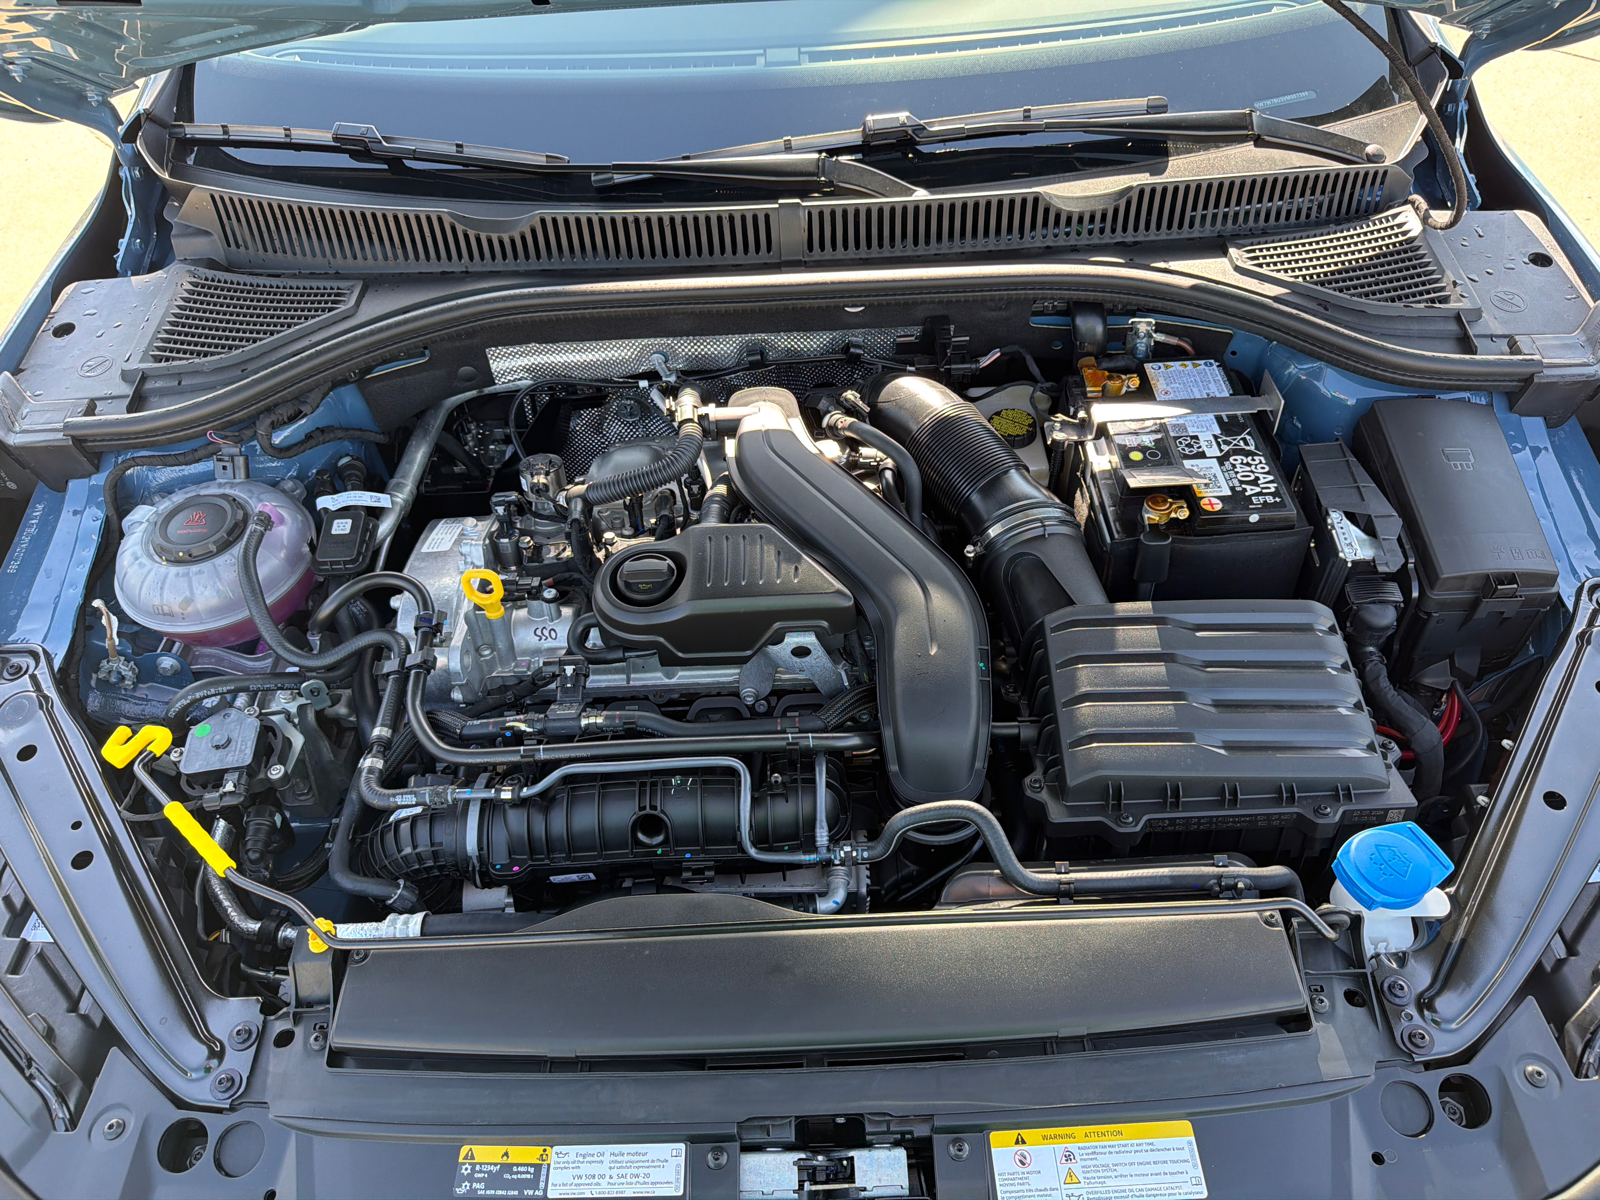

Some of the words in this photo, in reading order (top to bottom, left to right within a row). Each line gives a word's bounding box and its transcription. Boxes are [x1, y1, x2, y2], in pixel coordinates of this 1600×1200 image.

[1204, 440, 1212, 449] Pb
[1229, 456, 1255, 481] 640
[1242, 484, 1261, 496] A
[1248, 456, 1278, 493] 59Ah
[1084, 1130, 1123, 1138] ATTENTION
